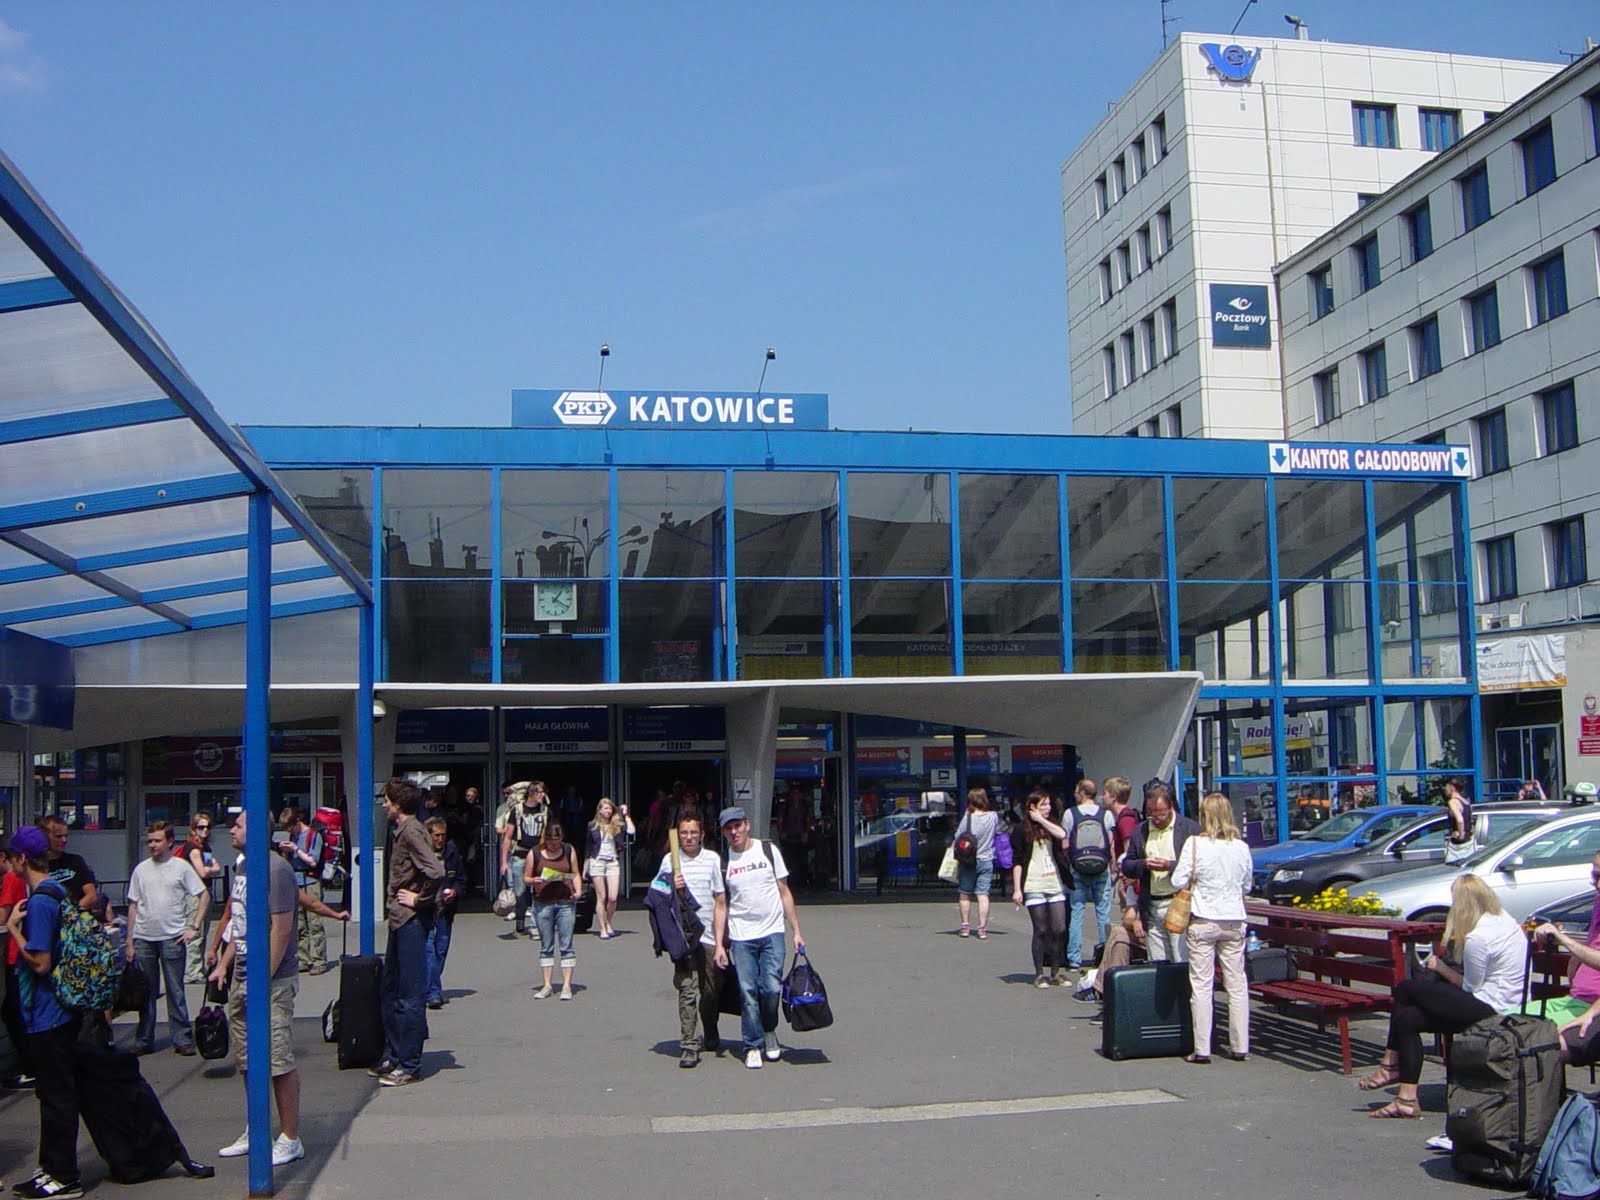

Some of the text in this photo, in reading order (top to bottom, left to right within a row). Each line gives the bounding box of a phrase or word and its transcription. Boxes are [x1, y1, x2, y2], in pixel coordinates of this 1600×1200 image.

[1215, 311, 1267, 326] Pocztowy
[1233, 323, 1250, 332] Bank
[563, 395, 796, 424] PKP KATOWICE
[1290, 448, 1451, 472] KANTOR CAŁODOBOWY
[524, 721, 549, 731] HALA
[900, 763, 908, 773] 2
[990, 761, 998, 772] 3
